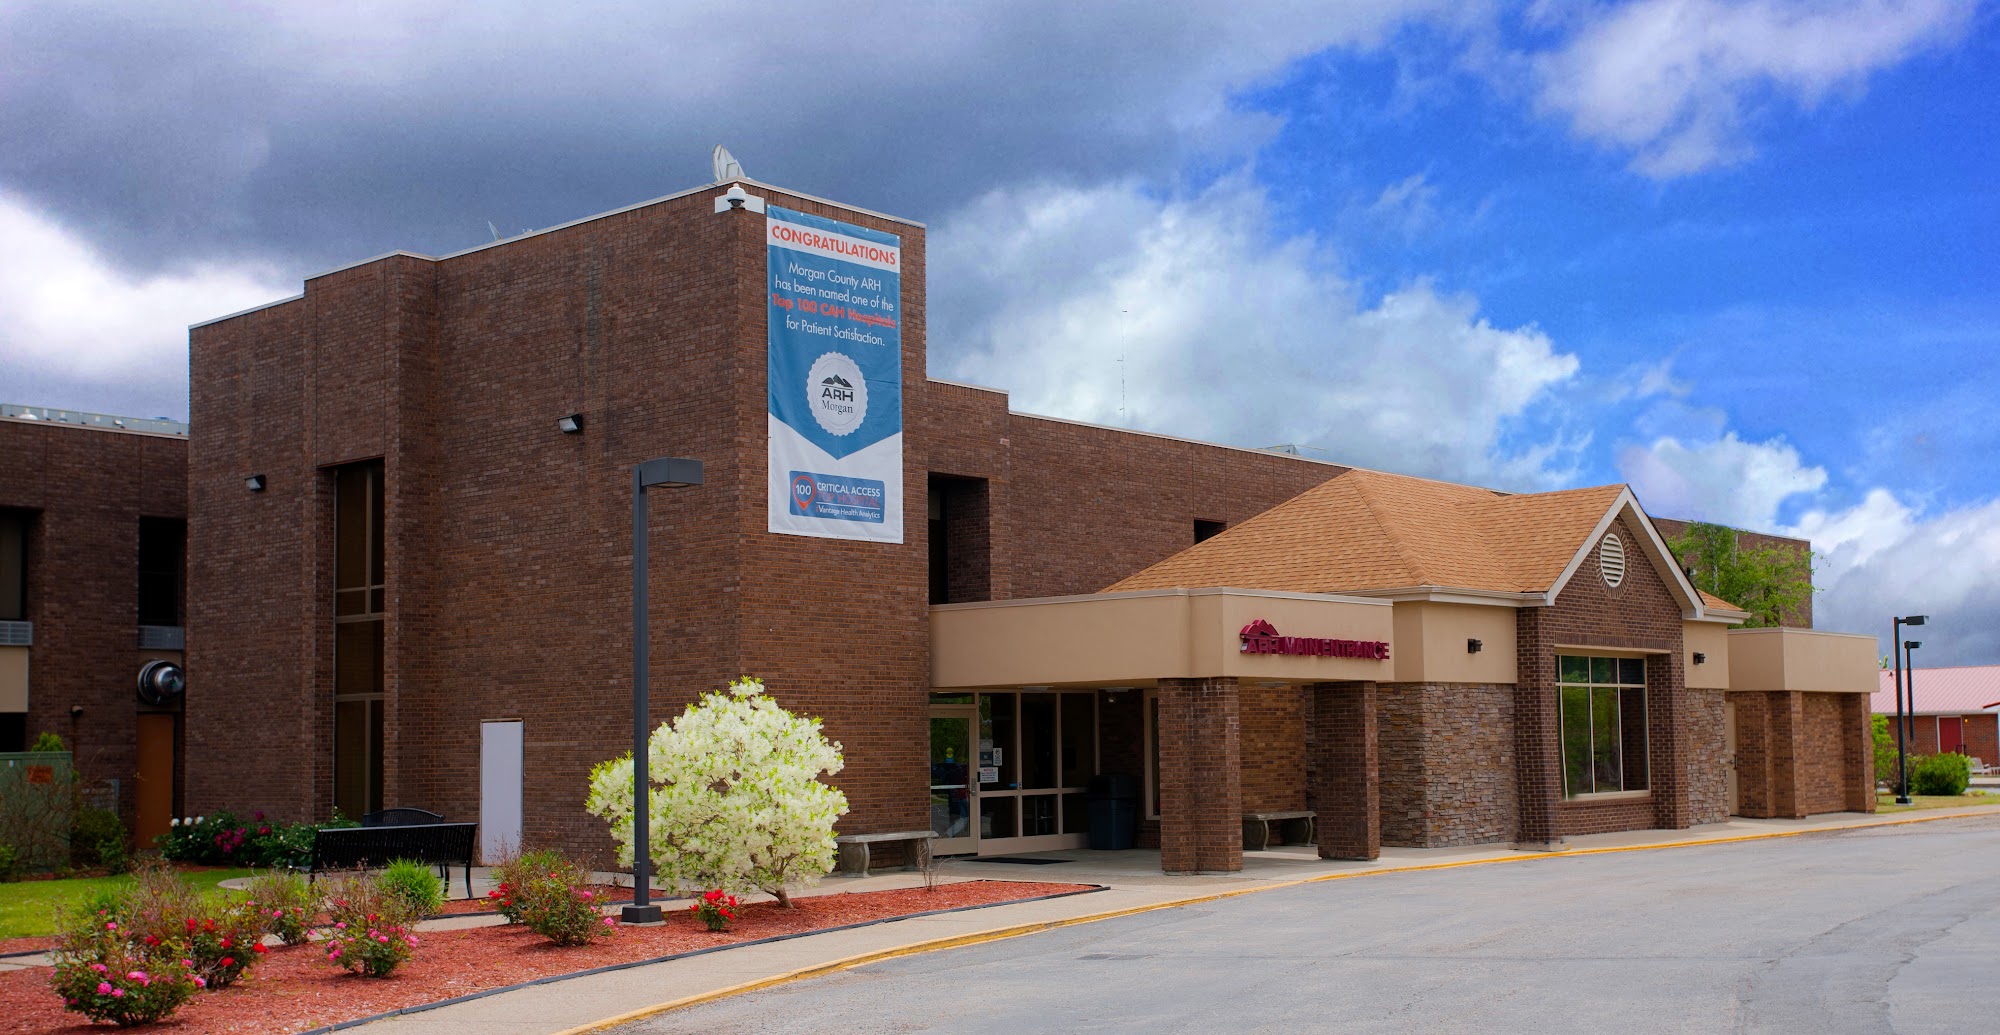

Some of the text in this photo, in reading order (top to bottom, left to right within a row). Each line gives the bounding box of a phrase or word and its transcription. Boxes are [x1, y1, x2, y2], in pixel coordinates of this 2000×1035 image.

[772, 226, 895, 265] CONGRATULATIONS
[788, 261, 881, 292] Morgan County ARH
[775, 274, 894, 312] has been named one of the
[772, 293, 896, 329] Top 100 CAH Hospitals
[786, 315, 885, 347] for Patient Satisfaction.
[822, 388, 853, 402] ARH
[822, 400, 853, 415] Morgan
[795, 484, 812, 496] 100
[817, 482, 880, 498] CRITICAL ACCESS
[817, 491, 880, 508] TOP HOSPITAL
[840, 507, 858, 517] Health
[859, 510, 880, 519] Analytics
[1320, 639, 1390, 660] ENTRANCE
